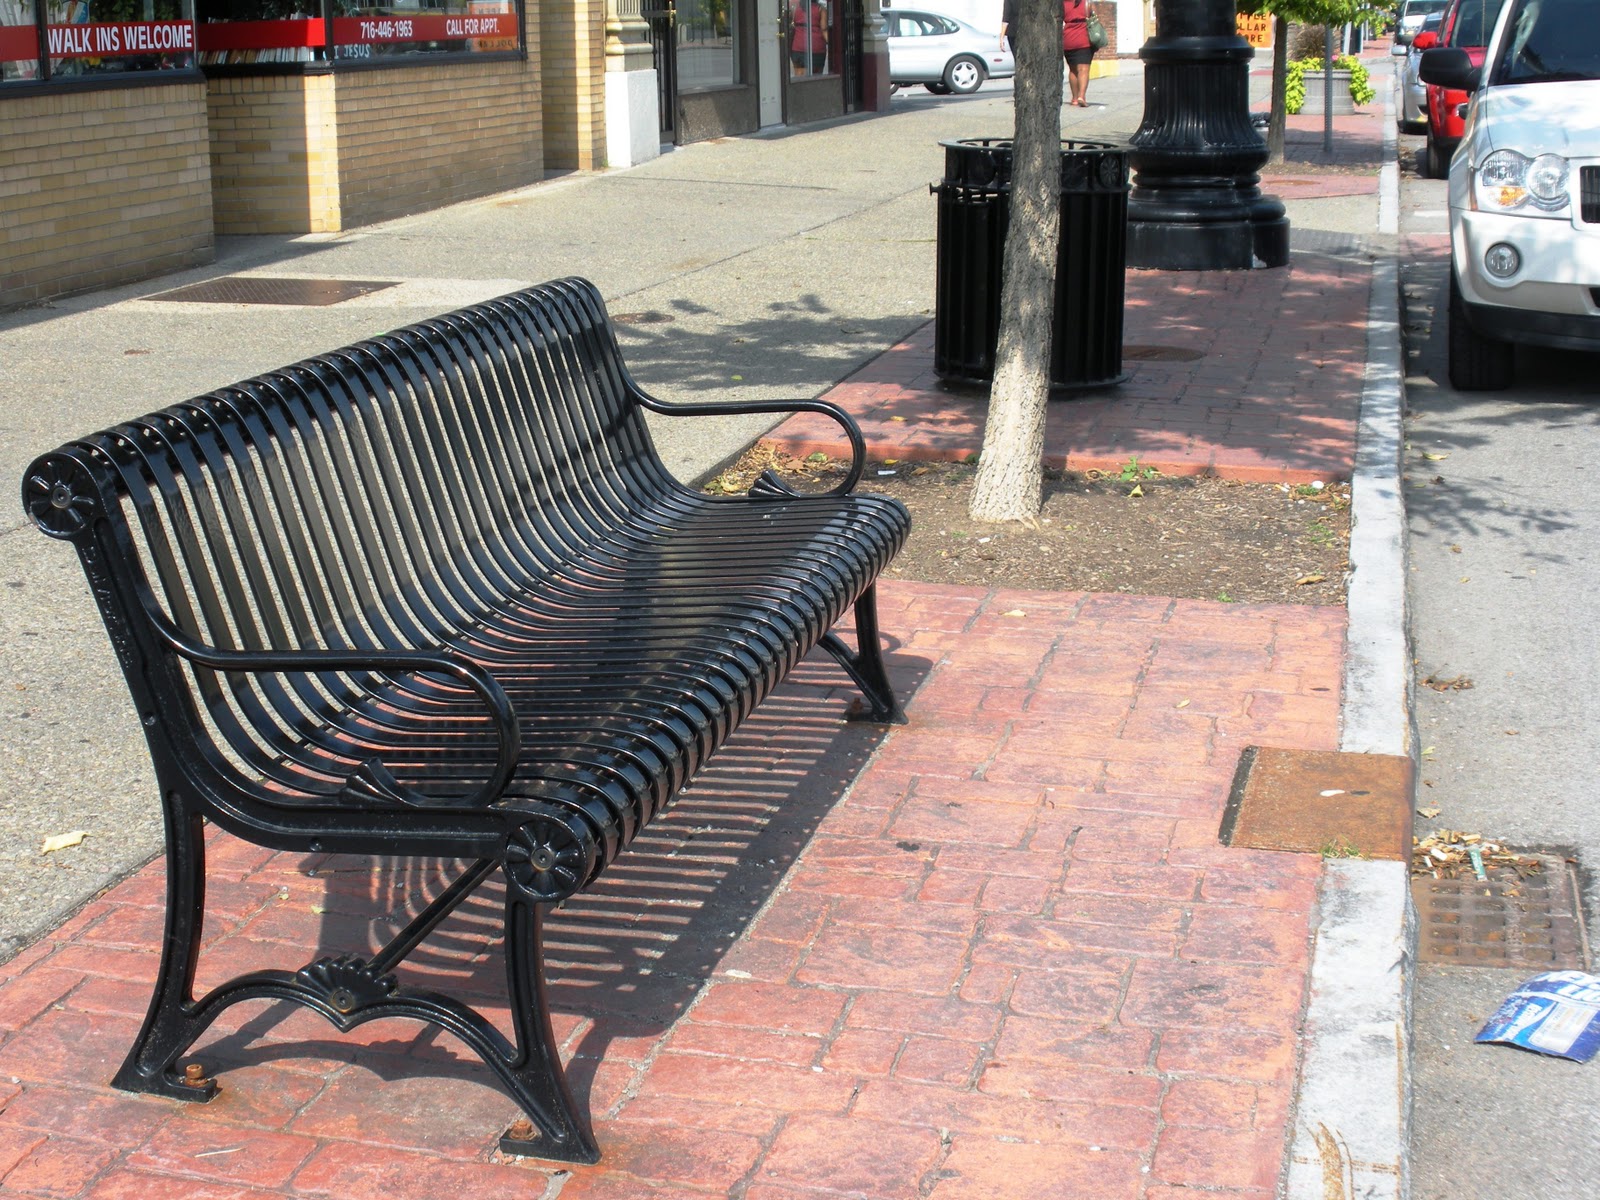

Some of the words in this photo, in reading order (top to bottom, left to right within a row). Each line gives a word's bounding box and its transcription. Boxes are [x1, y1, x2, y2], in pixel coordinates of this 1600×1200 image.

[360, 20, 413, 39] 716-446-1963
[446, 19, 463, 36] CALL
[464, 18, 479, 35] FOR
[480, 18, 500, 33] APPT.
[47, 28, 92, 54] WALK
[96, 26, 120, 51] INS
[123, 24, 192, 50] WELCOME
[343, 44, 371, 58] JESUS
